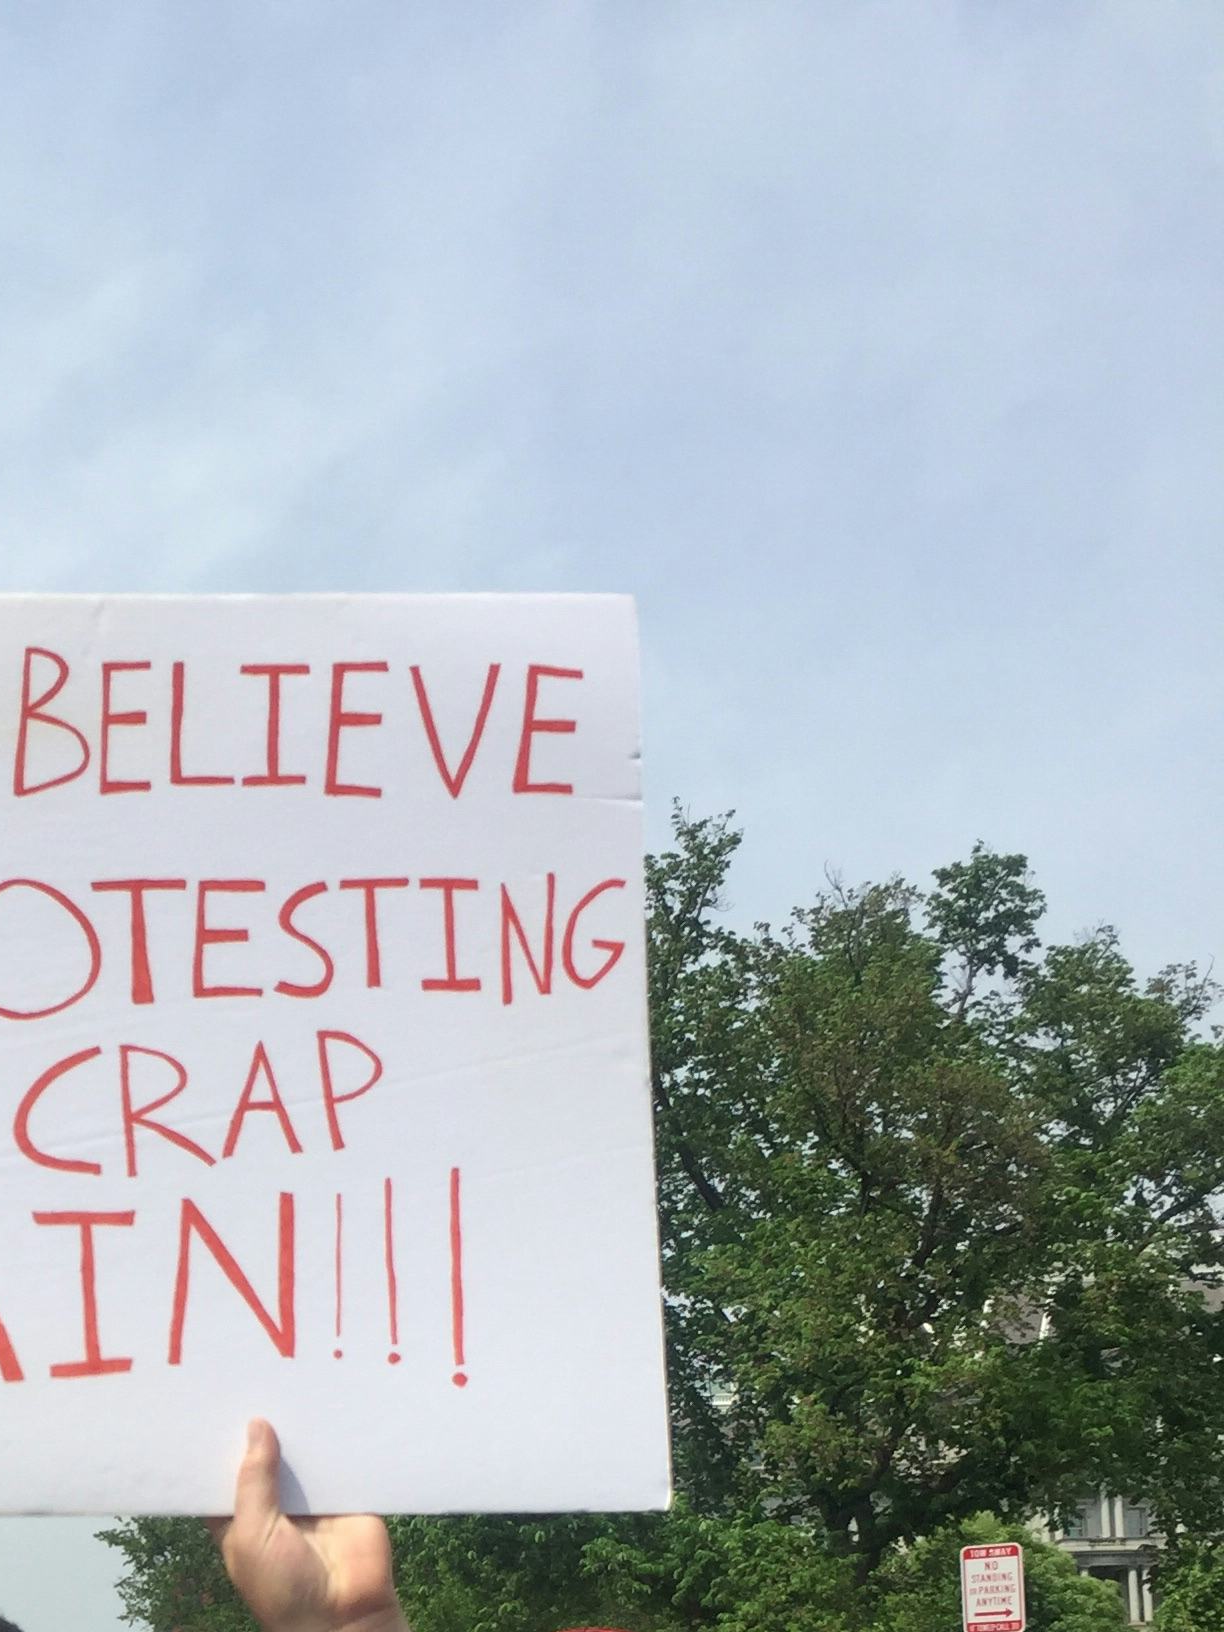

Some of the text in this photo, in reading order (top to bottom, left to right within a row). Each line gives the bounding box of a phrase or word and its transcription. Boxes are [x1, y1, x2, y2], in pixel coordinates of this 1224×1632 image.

[13, 646, 585, 799] BELIEVE
[12, 1029, 384, 1178] CRAP
[984, 1561, 998, 1570] NO
[971, 1572, 1013, 1583] STANDING
[979, 1583, 1016, 1595] PARKING
[976, 1596, 1012, 1607] ANYTIME
